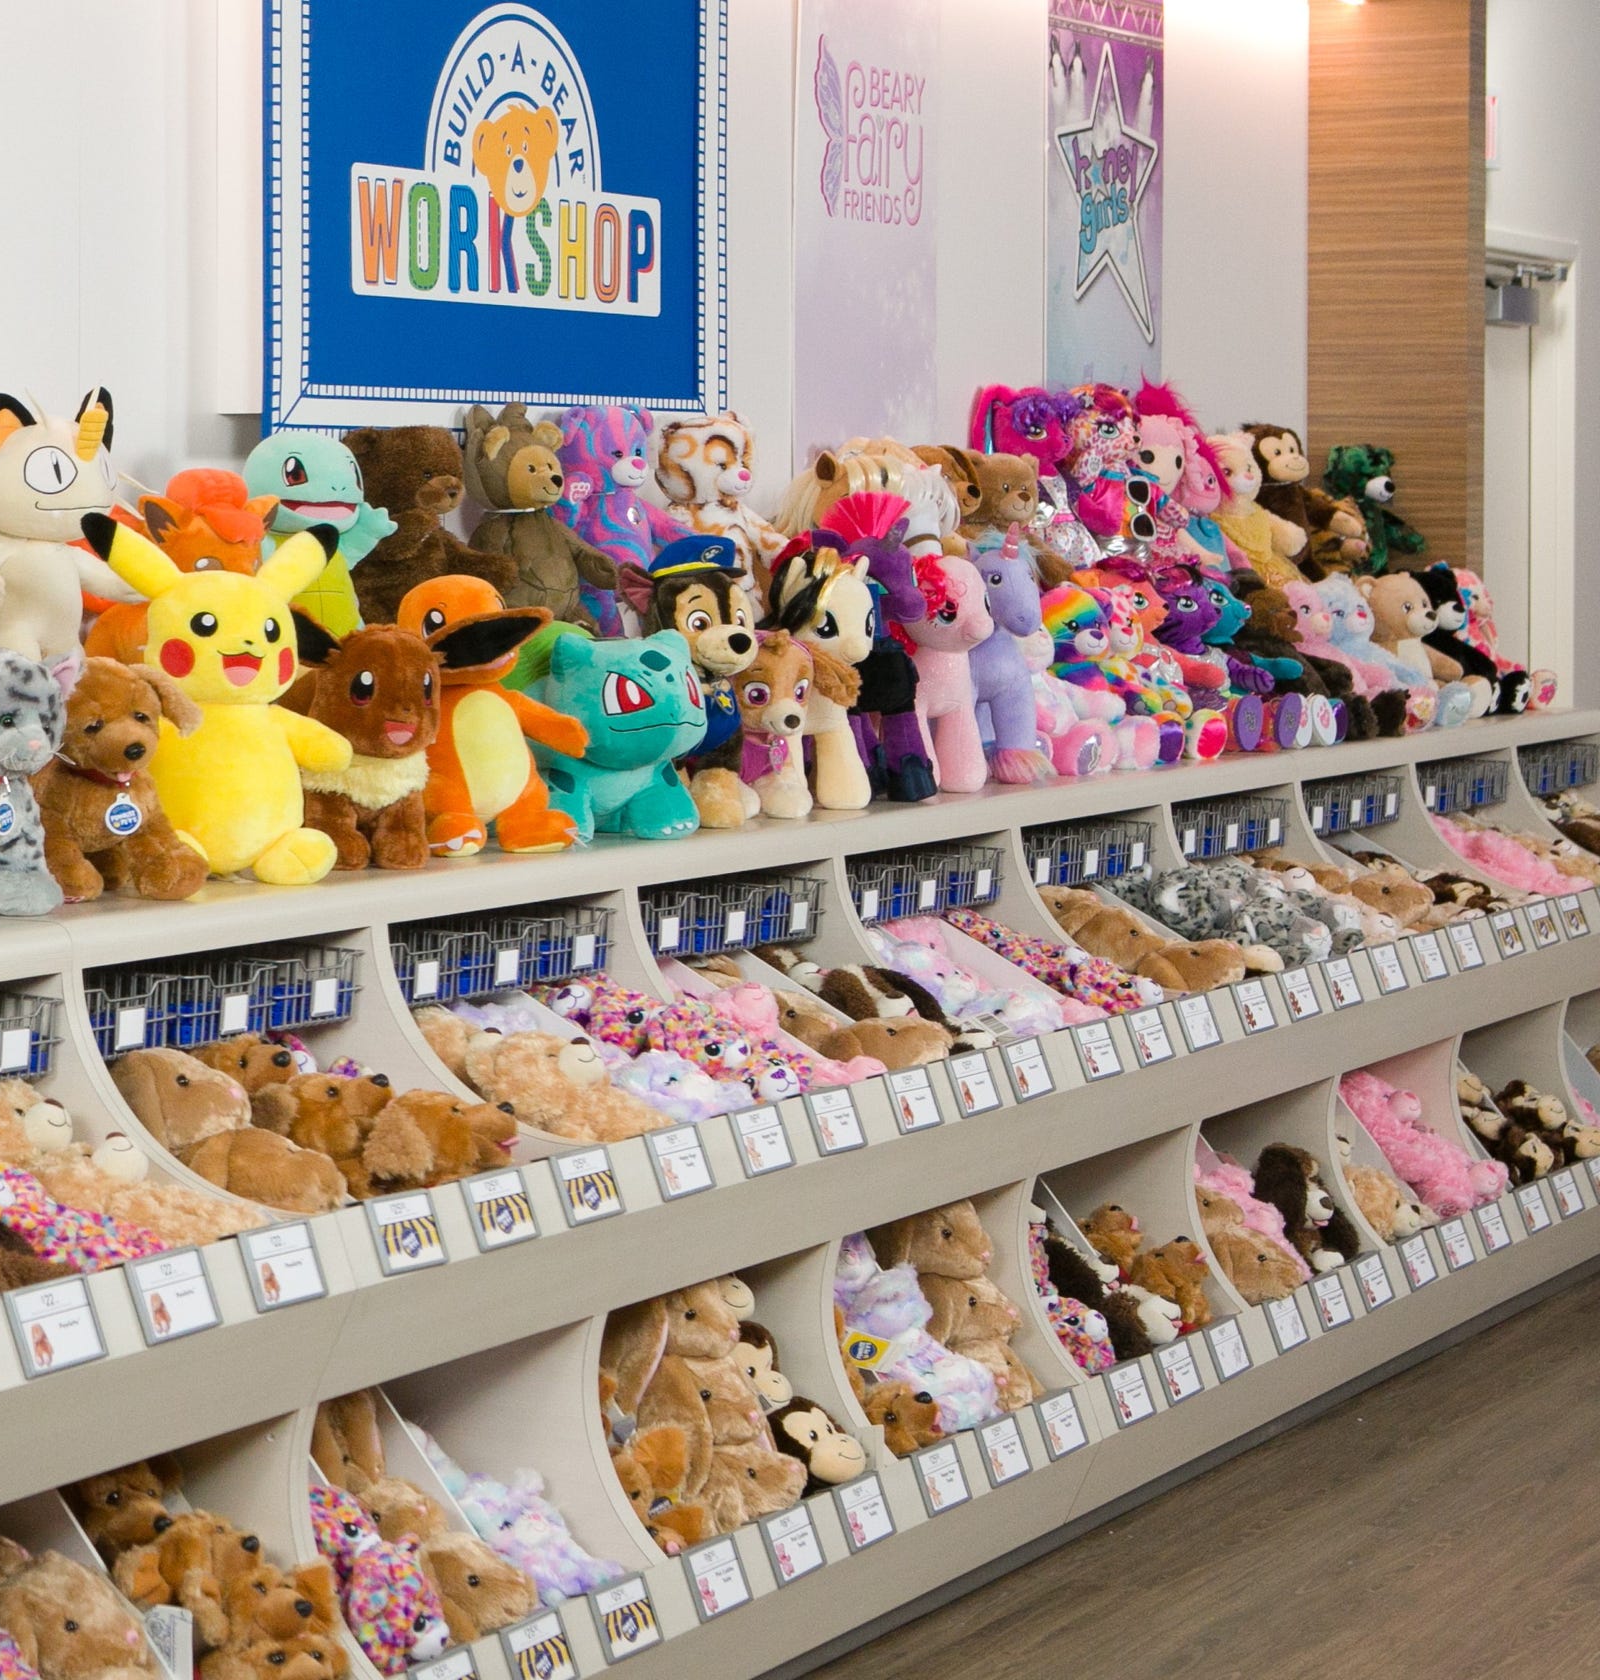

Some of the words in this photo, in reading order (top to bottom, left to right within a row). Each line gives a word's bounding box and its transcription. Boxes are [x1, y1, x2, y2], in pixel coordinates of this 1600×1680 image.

[444, 39, 585, 178] BUILD-A-BEAR
[869, 66, 925, 114] BEARY
[357, 175, 655, 304] WORKSHOP
[843, 188, 902, 226] FRIENDS
